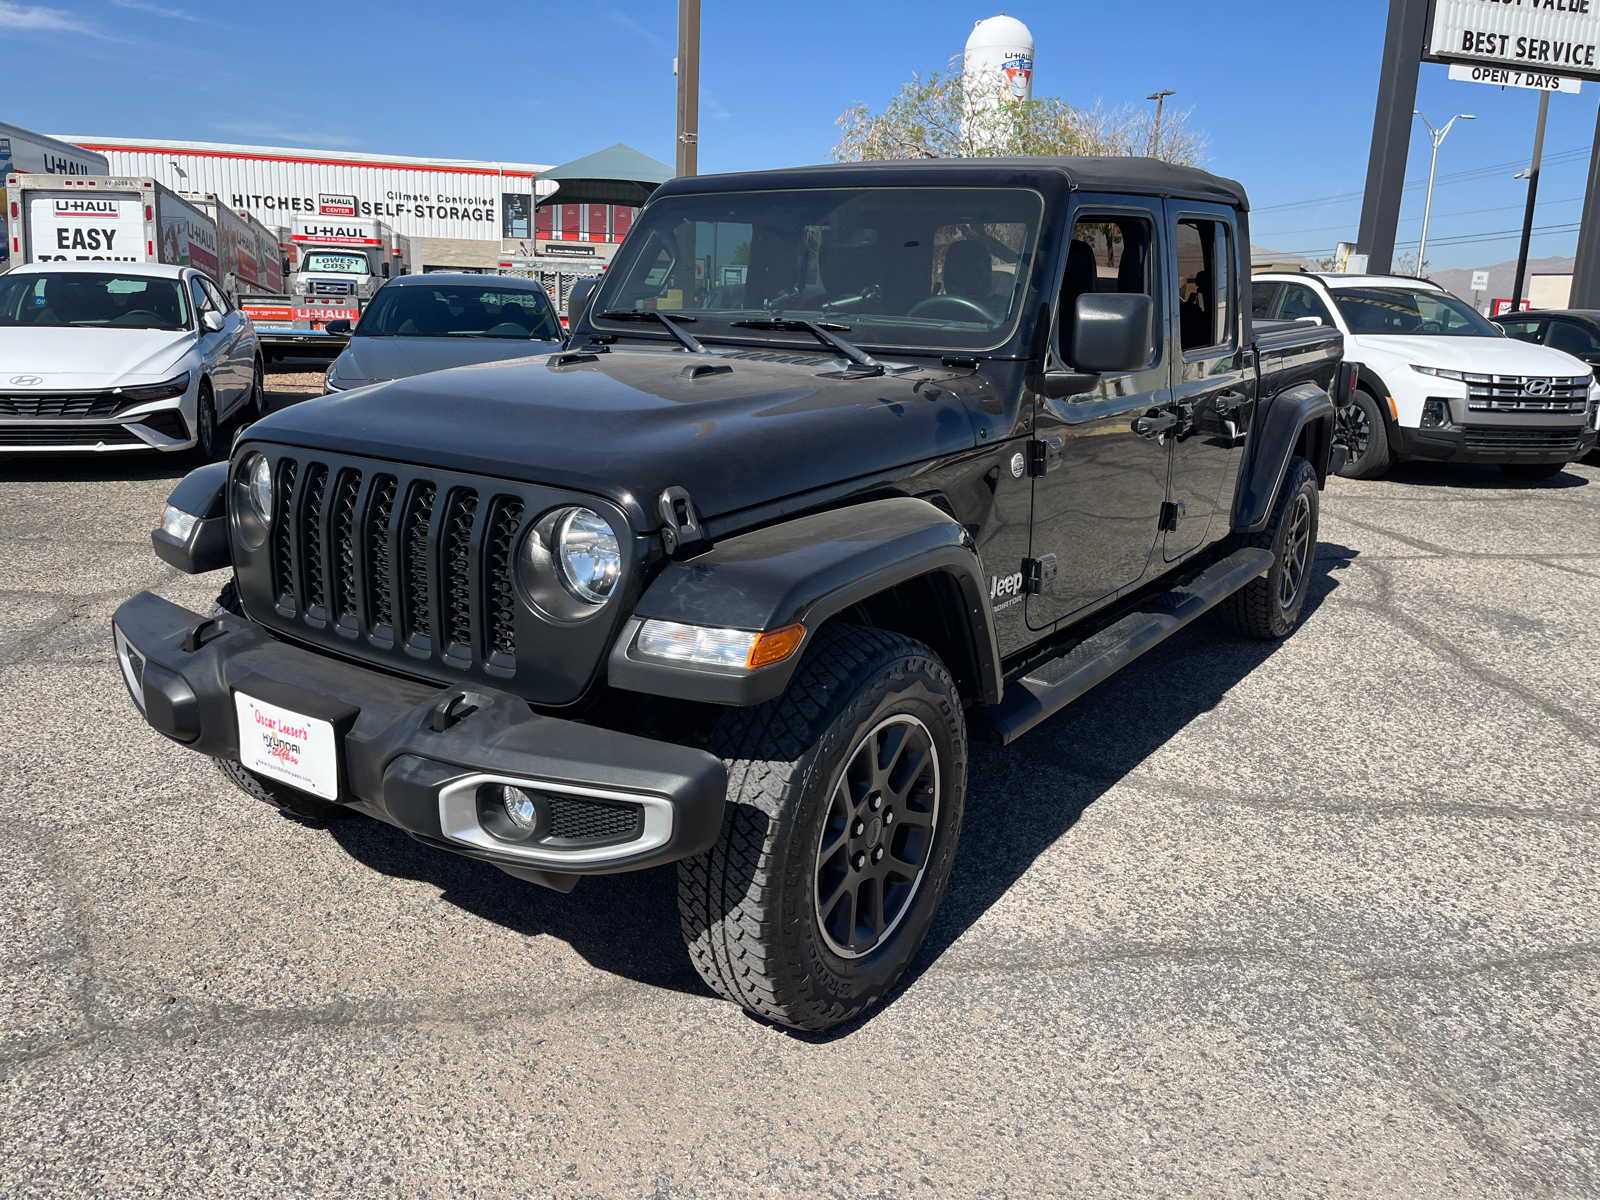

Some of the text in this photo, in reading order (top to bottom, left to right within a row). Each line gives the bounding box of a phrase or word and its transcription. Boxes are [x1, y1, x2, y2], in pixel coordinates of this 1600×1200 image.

[1462, 30, 1595, 66] BEST SERVICE
[1472, 67, 1560, 89] OPEN 7 DAYS
[55, 200, 117, 212] U-HAUL
[232, 193, 315, 211] HITCHES
[321, 197, 353, 206] U-HAUL
[387, 191, 495, 206] Climate Controlled
[361, 201, 495, 222] SELF-STORAGE
[56, 227, 117, 250] EASY
[187, 220, 216, 252] U-HAUL
[304, 225, 367, 238] U-HAUL
[315, 256, 360, 265] LOWEST
[297, 308, 355, 320] U-HAUL
[990, 571, 1023, 600] Jeep
[992, 595, 1022, 613] ADIATOR
[254, 708, 308, 741] Oscar Leeser's
[262, 732, 301, 755] HYUNDAI
